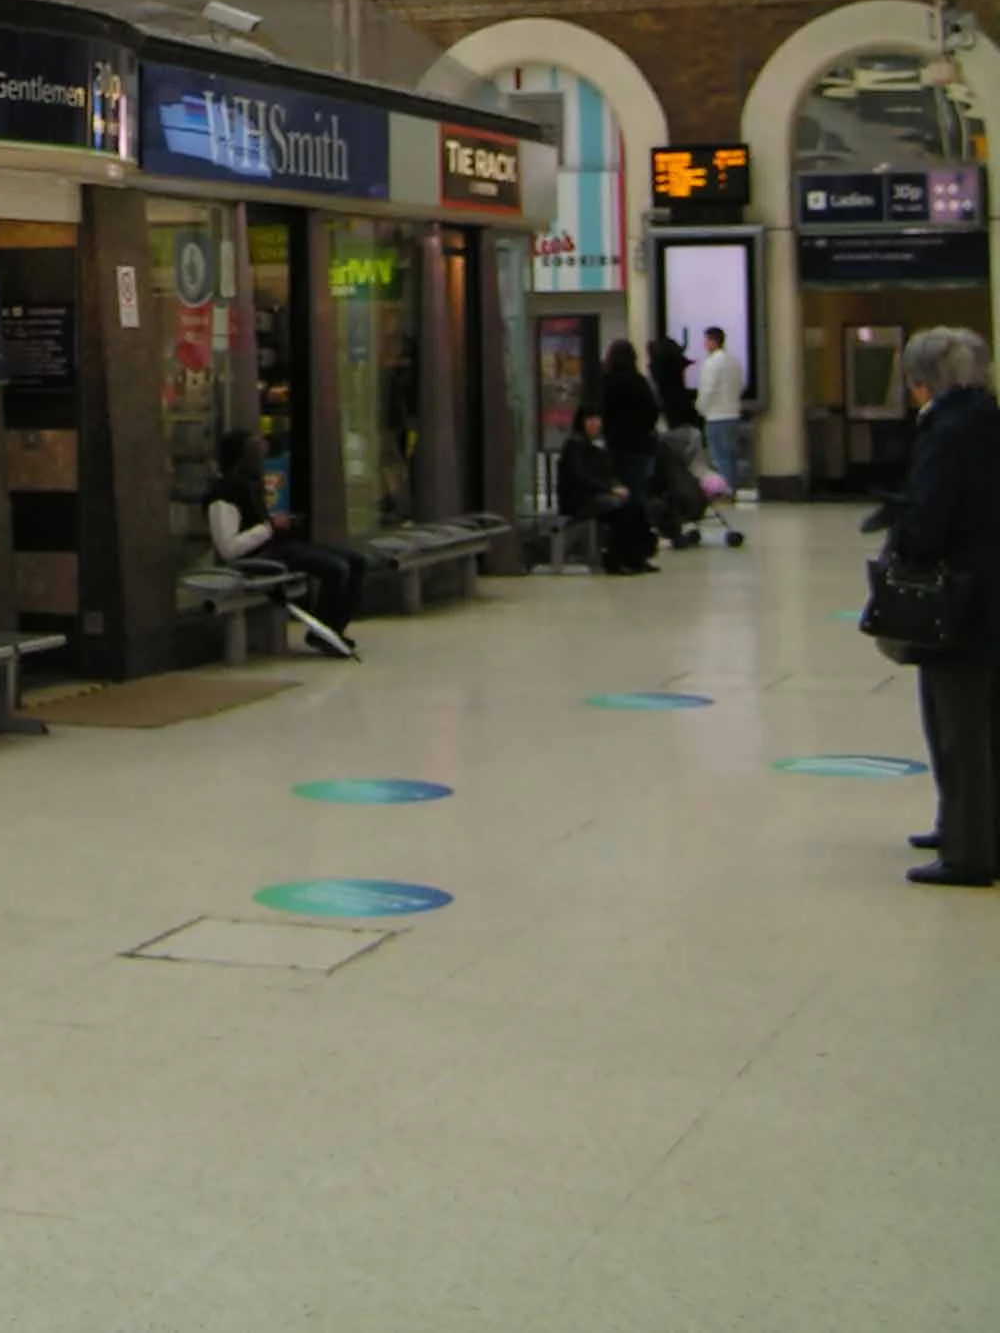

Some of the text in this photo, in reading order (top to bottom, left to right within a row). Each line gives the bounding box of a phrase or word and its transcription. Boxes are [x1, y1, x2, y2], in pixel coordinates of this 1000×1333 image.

[202, 90, 350, 182] WHSmith
[444, 139, 517, 184] TIE RACK
[830, 192, 876, 208] Ladies
